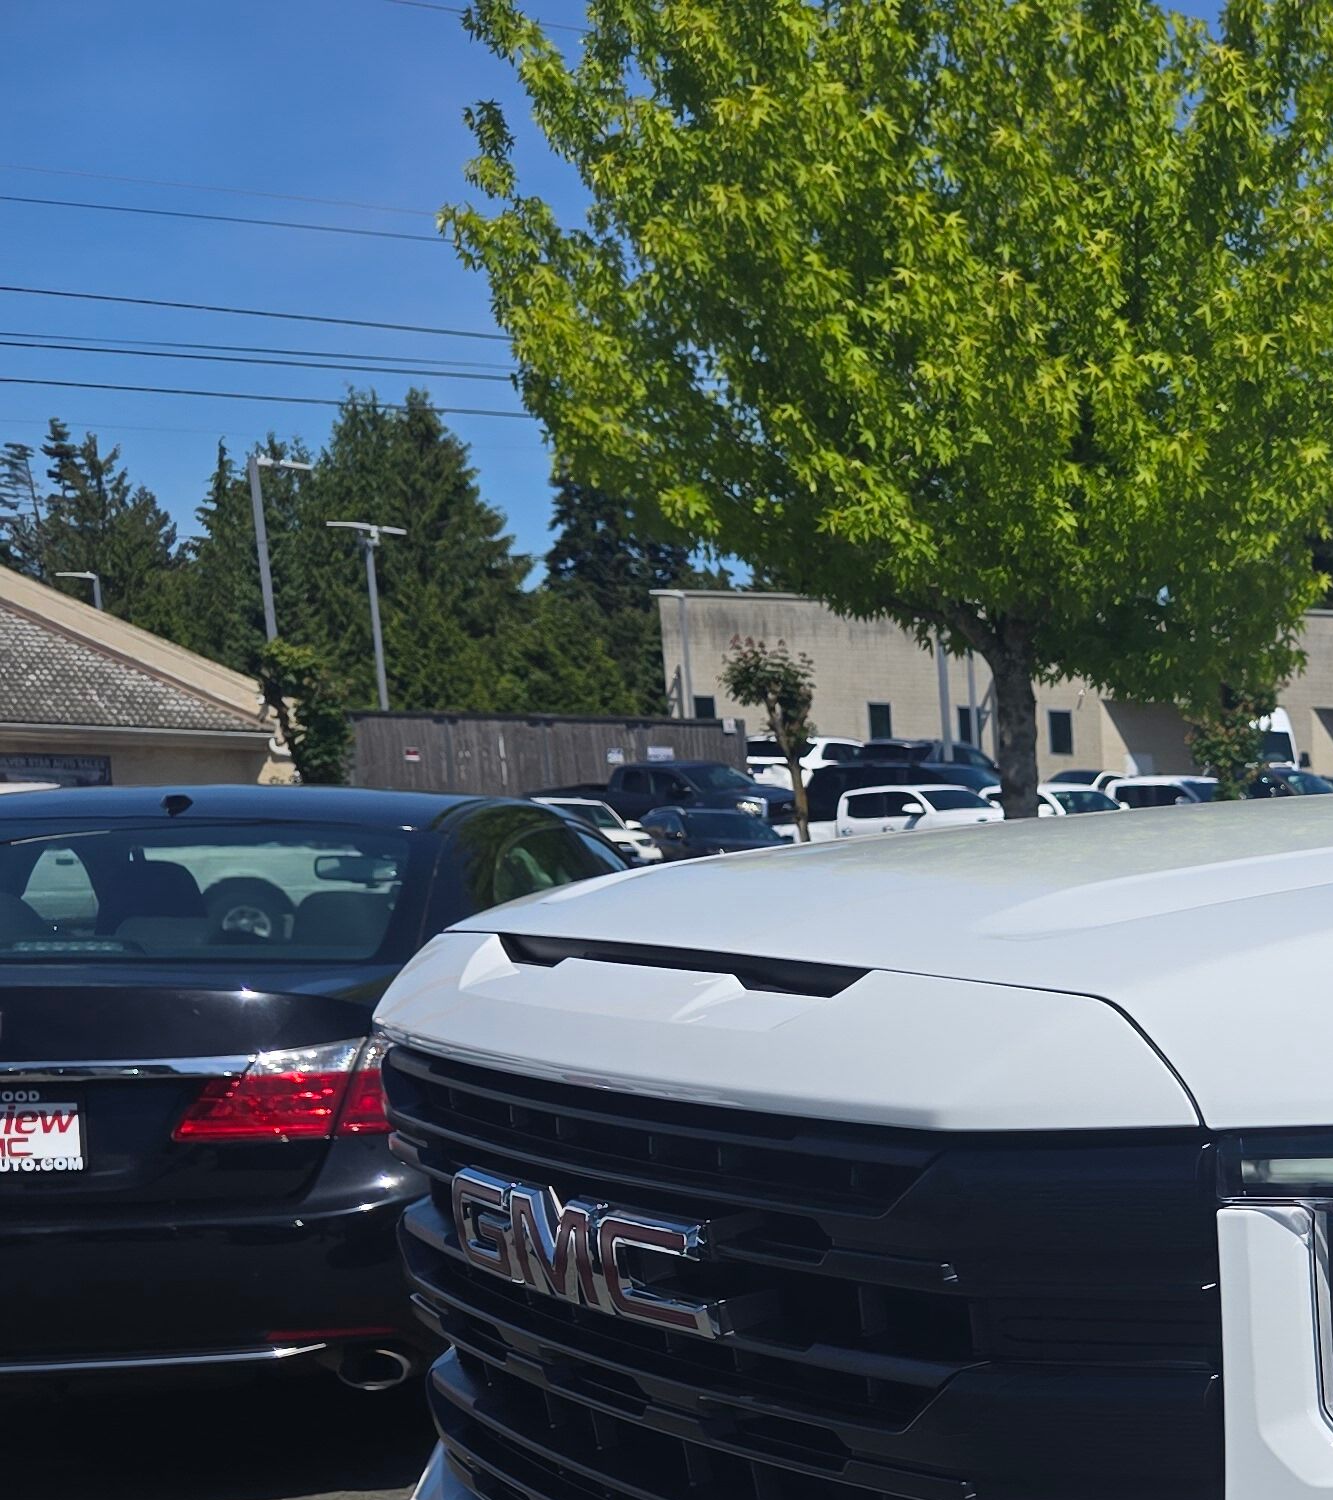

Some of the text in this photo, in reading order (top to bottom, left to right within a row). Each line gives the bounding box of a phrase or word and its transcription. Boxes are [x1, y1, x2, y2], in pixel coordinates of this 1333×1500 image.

[0, 1091, 40, 1101] OOD
[0, 1104, 77, 1134] iew
[452, 1167, 730, 1340] GMC
